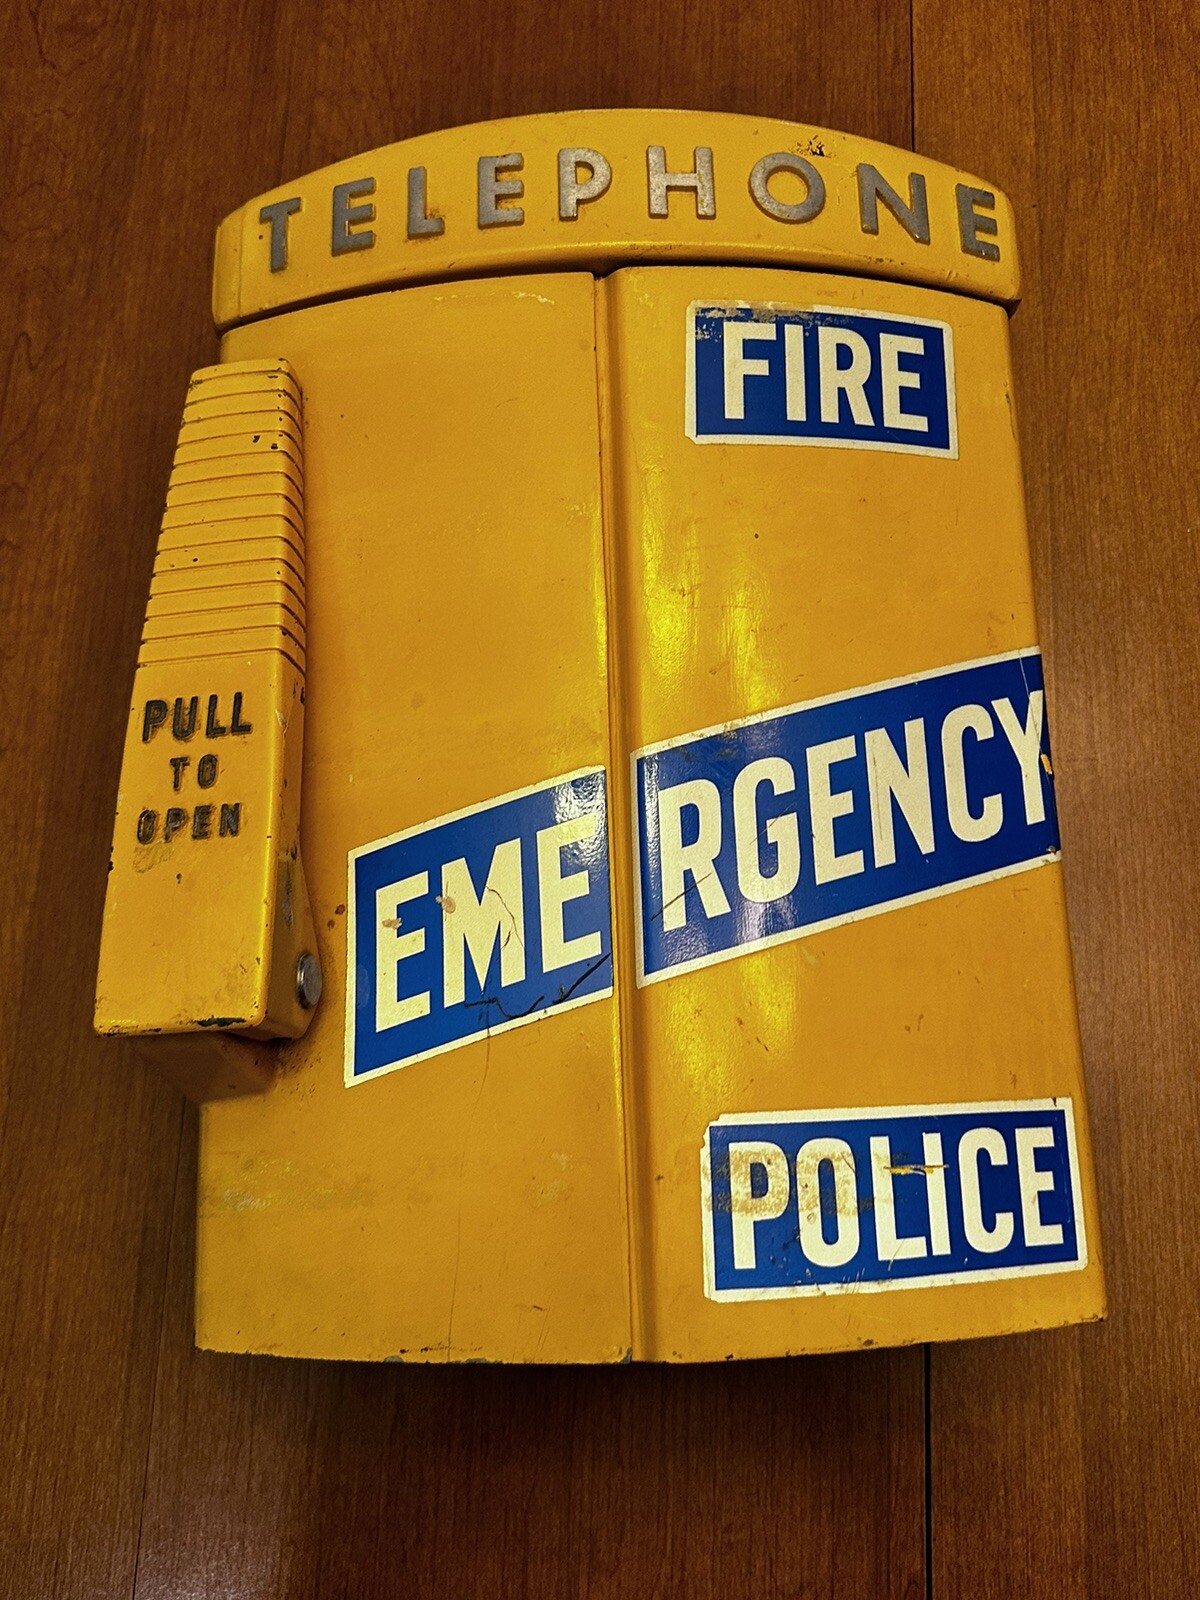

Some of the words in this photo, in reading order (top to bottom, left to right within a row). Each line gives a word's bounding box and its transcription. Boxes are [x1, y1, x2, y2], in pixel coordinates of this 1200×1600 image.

[258, 145, 1001, 273] TELEPHONE
[722, 320, 930, 432] FIRE
[142, 691, 252, 743] PULL
[170, 753, 218, 792] TO
[137, 802, 241, 845] OPEN
[728, 1127, 1064, 1269] POLICE
